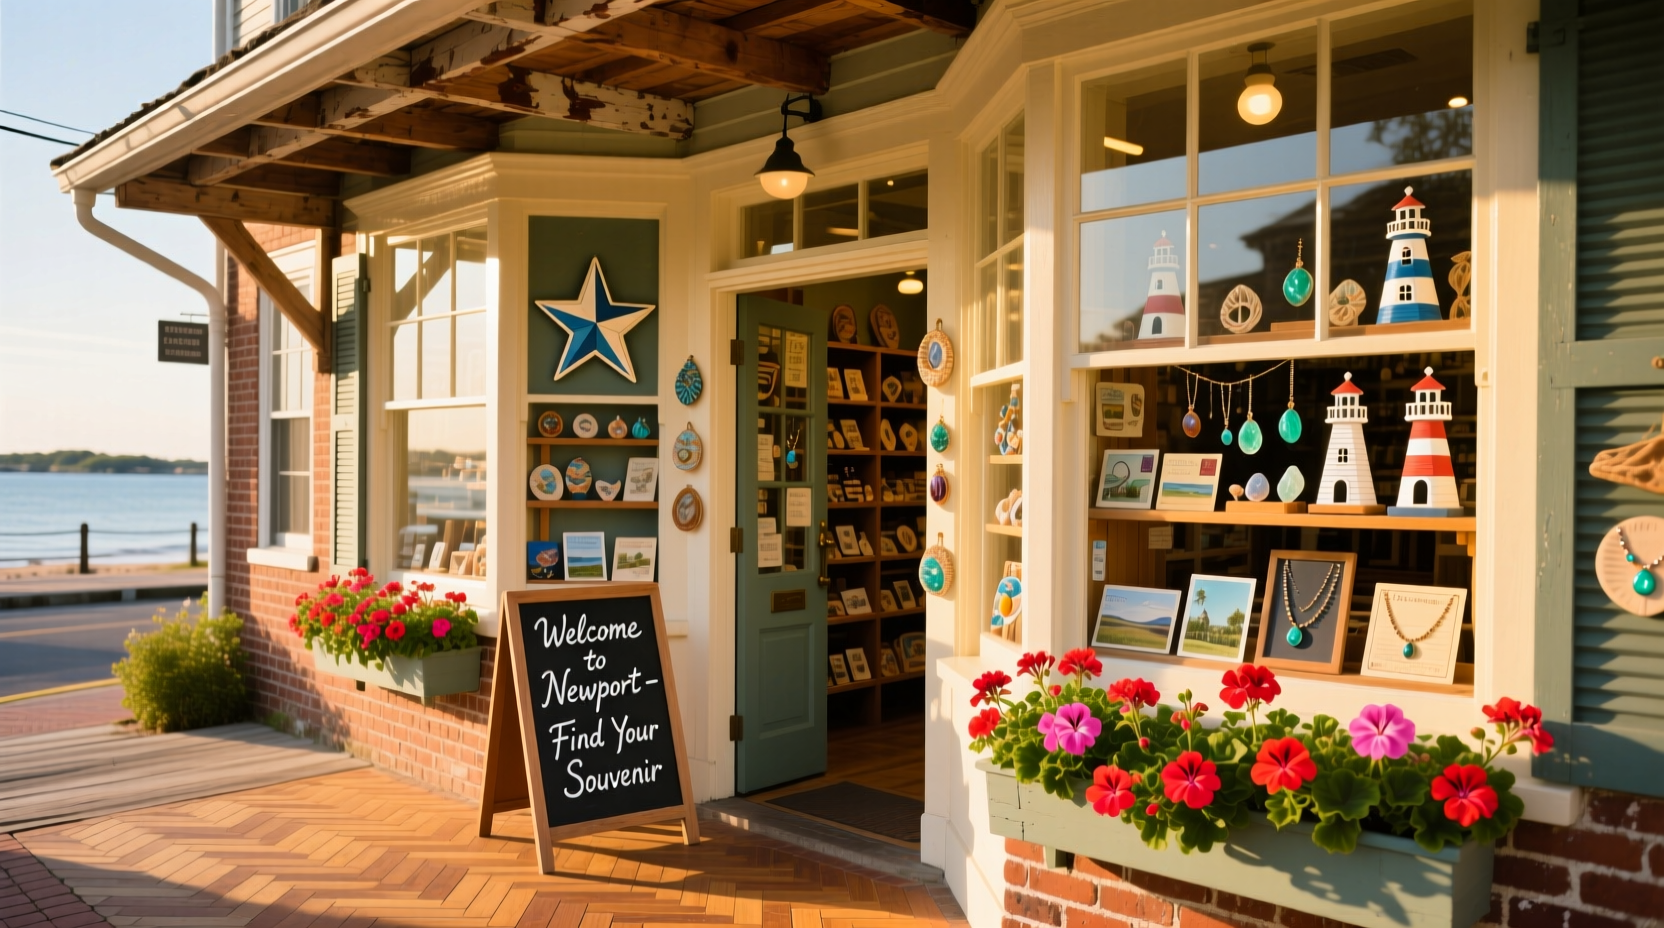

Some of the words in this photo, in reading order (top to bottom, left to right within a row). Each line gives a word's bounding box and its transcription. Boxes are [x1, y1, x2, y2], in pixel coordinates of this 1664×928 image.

[534, 613, 642, 648] Welcome
[583, 649, 607, 671] to
[549, 718, 604, 761] Find
[611, 715, 659, 754] Your
[564, 758, 663, 799] Souvenir
